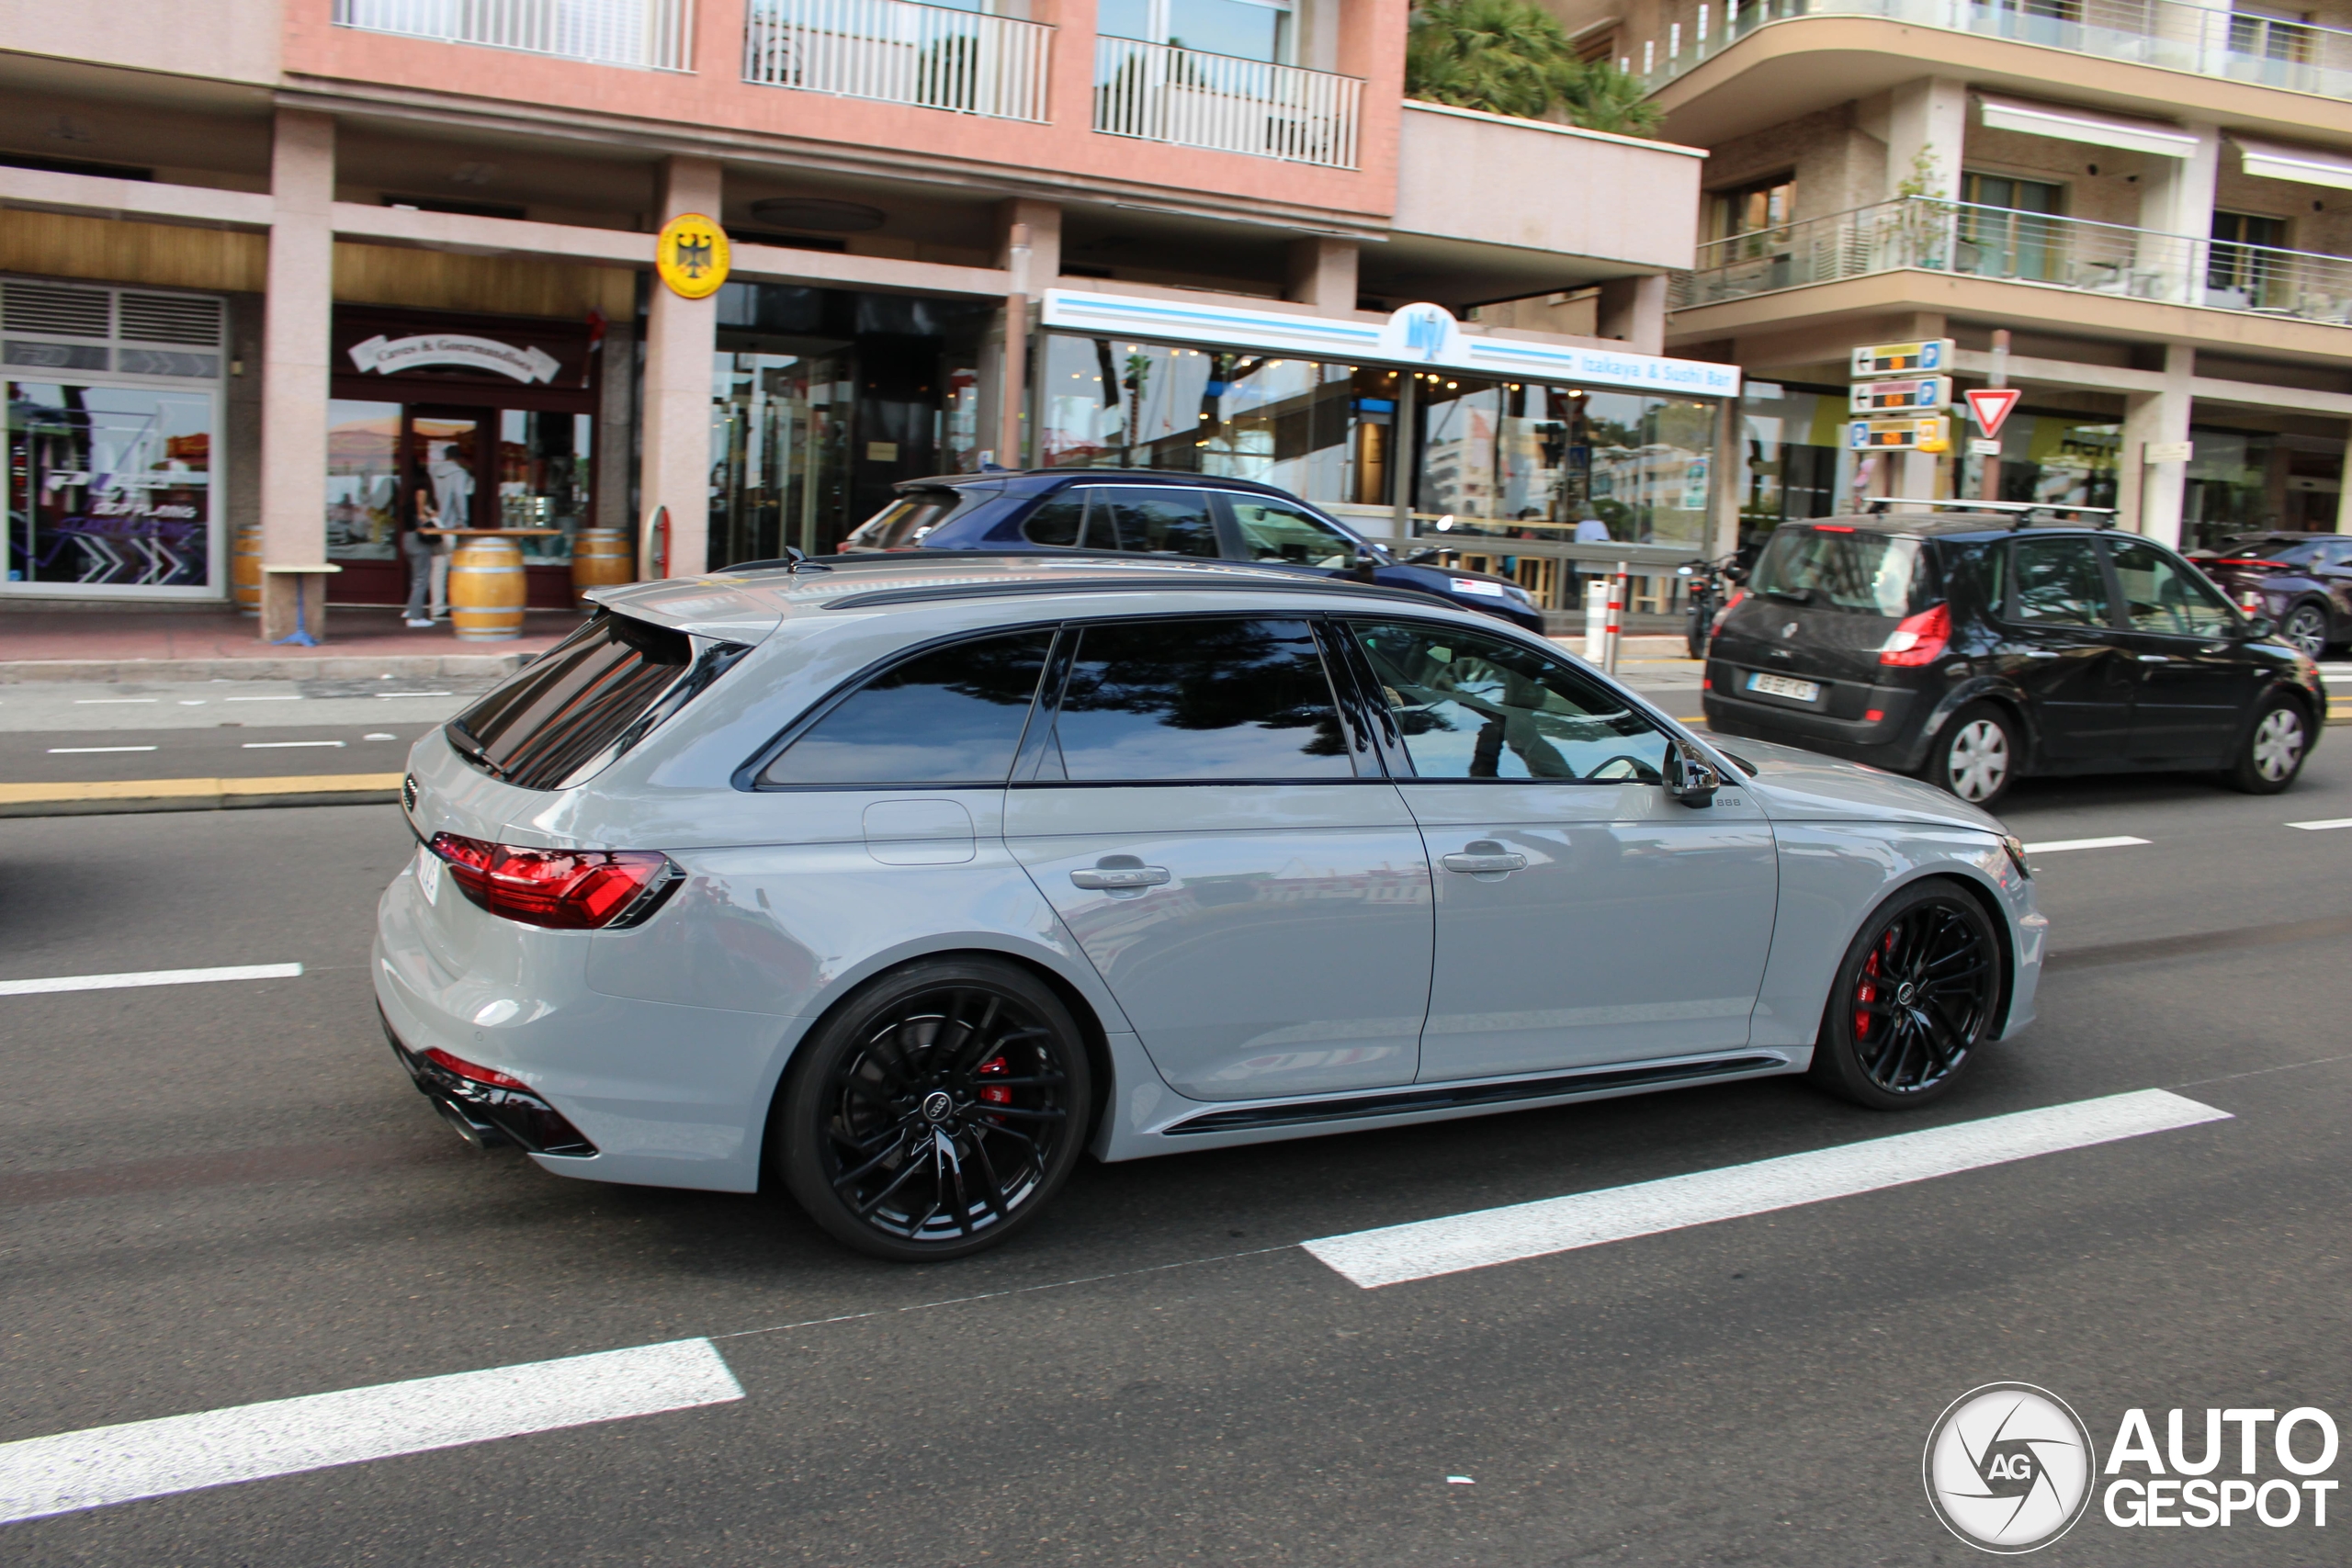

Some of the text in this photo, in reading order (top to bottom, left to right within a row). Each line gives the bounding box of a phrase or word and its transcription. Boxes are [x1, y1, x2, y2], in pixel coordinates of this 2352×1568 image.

[1582, 357, 1731, 387] Izakaya & Sushi Bar
